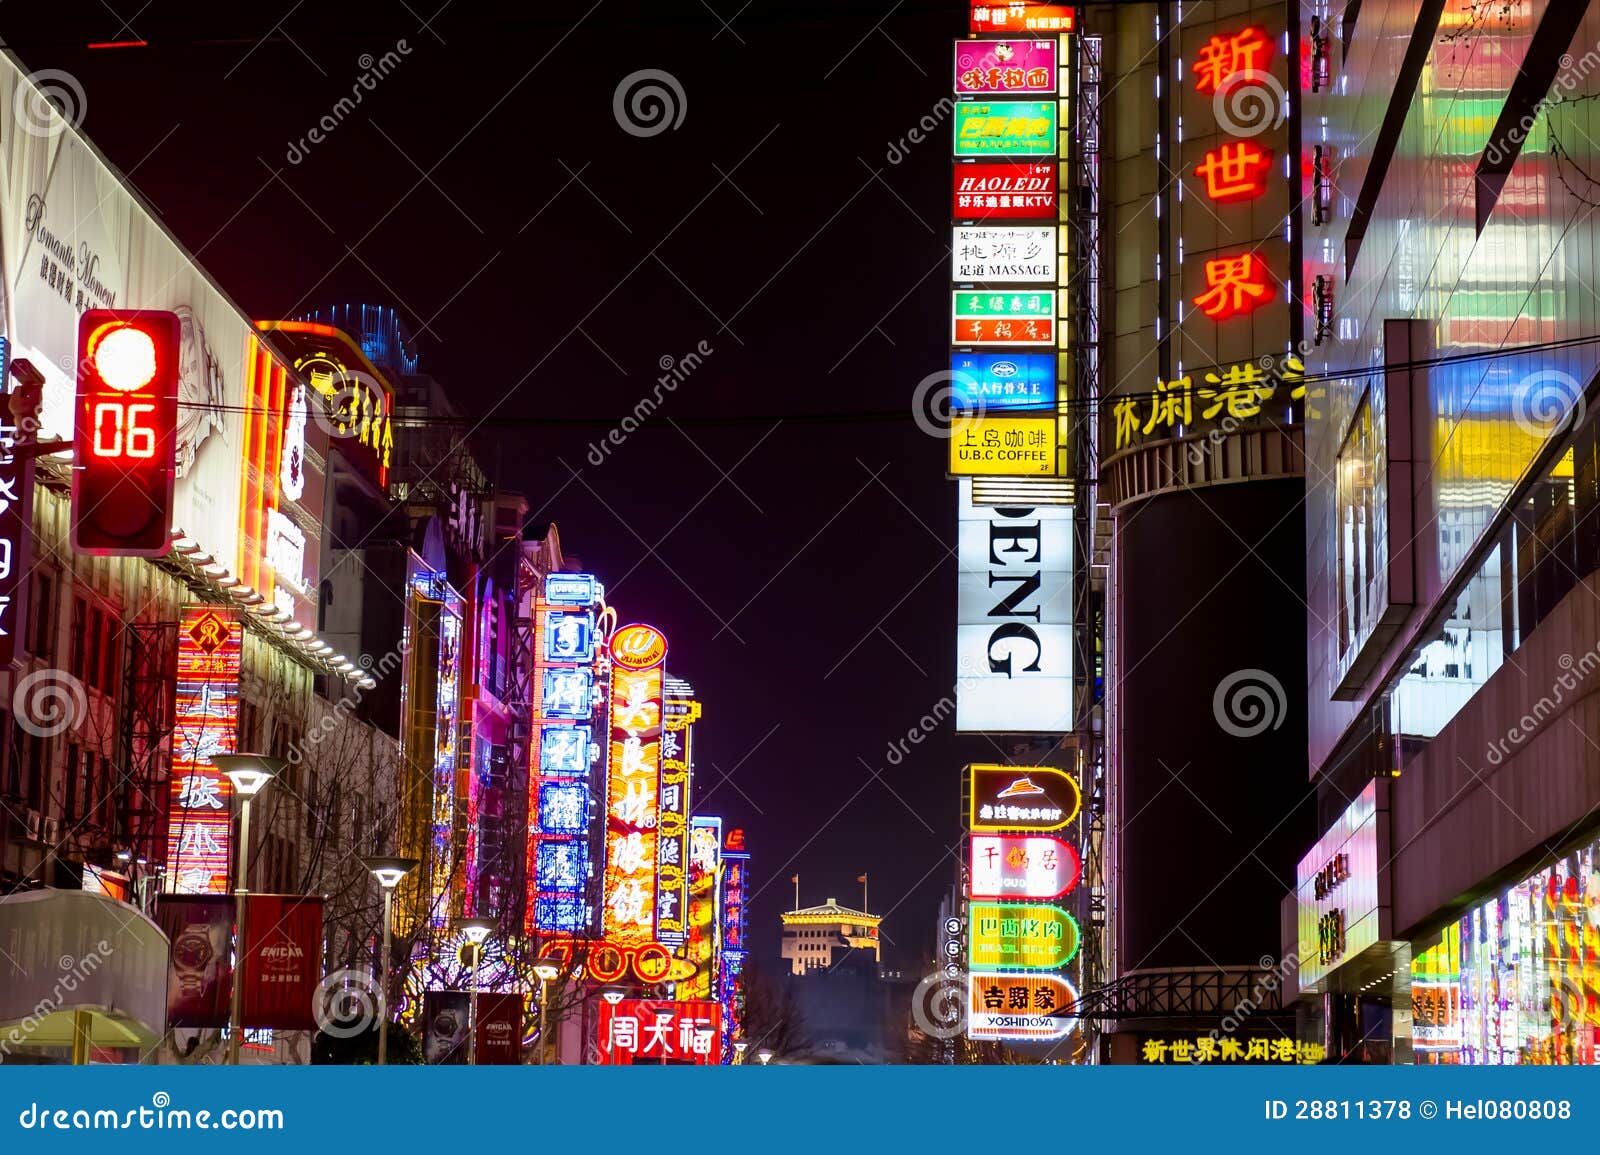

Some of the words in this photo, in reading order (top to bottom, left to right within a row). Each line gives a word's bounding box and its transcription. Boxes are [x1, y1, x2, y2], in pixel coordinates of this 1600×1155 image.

[1192, 27, 1266, 317] 新世界
[959, 177, 1051, 191] HAOLEDI
[77, 241, 117, 309] Moment
[989, 264, 1050, 276] MASSAGE
[93, 402, 156, 459] 06
[959, 429, 1047, 448] 上岛咖啡
[959, 450, 994, 460] U.B.C
[998, 450, 1047, 460] COFFEE
[987, 507, 1042, 680] ENG
[260, 946, 304, 958] ENICAR
[984, 986, 1055, 1009] 吉野家
[988, 1017, 1053, 1027] YOSHINOYA
